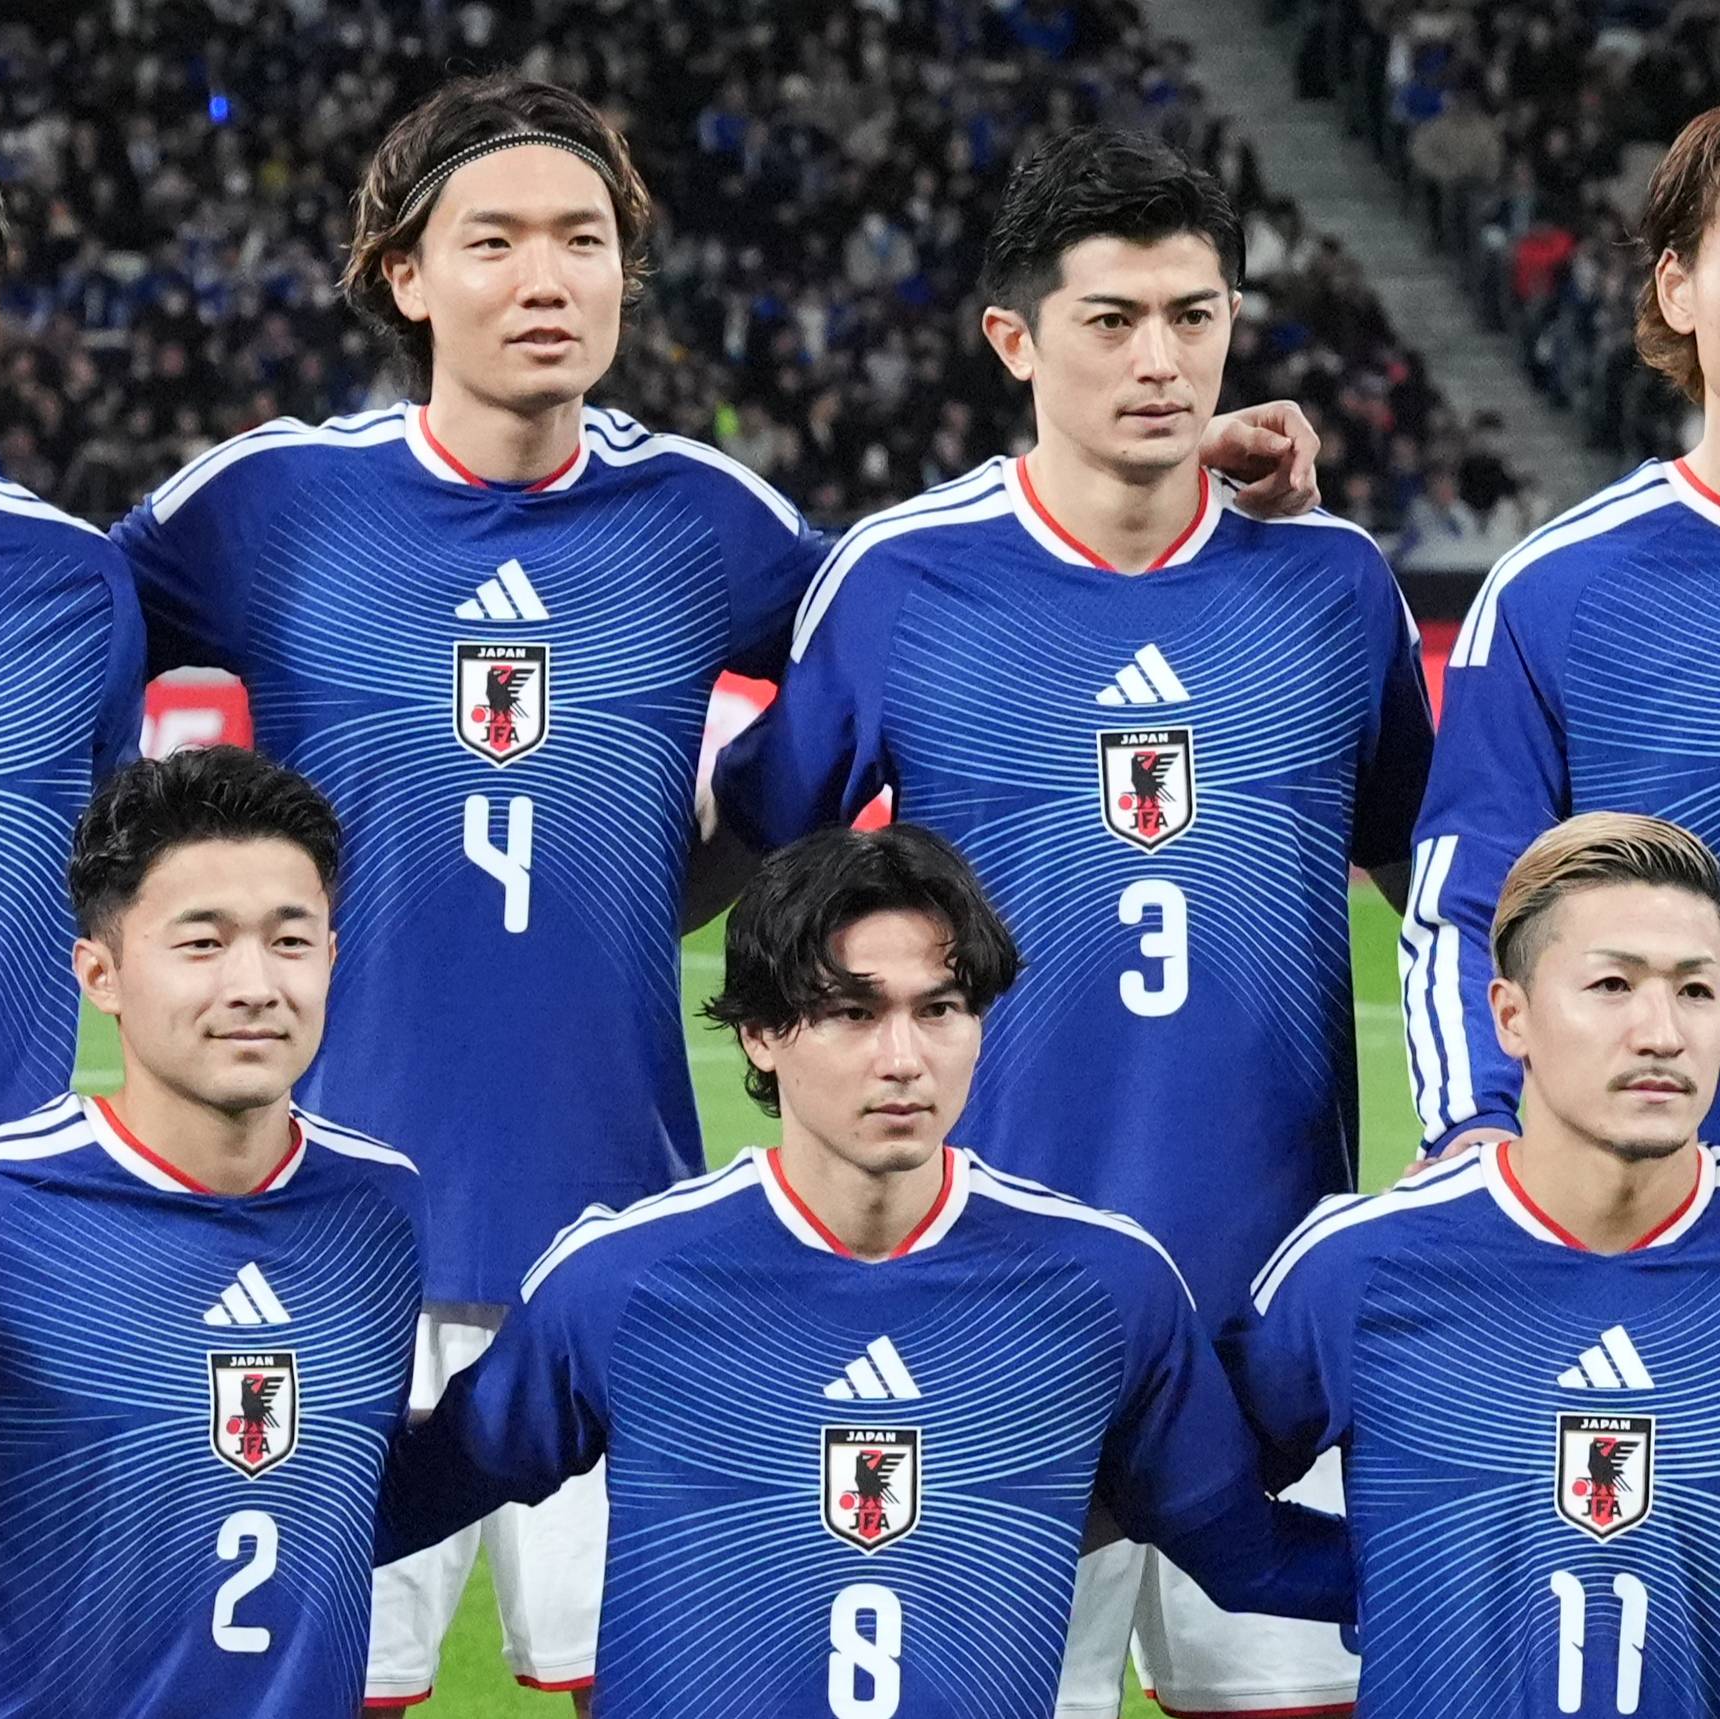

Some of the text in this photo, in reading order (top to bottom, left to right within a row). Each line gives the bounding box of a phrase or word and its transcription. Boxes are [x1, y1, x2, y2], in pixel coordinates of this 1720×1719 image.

[478, 648, 526, 659] JAPAN
[481, 726, 520, 743] JFA
[1120, 733, 1169, 745] JAPAN
[1130, 811, 1168, 829] JFA
[464, 795, 534, 933] 4
[1119, 879, 1189, 1017] 3
[230, 1356, 274, 1366] JAPAN
[1581, 1418, 1630, 1430] JAPAN
[846, 1431, 896, 1442] JAPAN
[235, 1437, 271, 1455] JFA
[1582, 1499, 1622, 1517] JFA
[849, 1512, 890, 1530] JFA
[212, 1510, 278, 1653] 2
[828, 1583, 902, 1719] 8
[1550, 1571, 1648, 1715] 11
